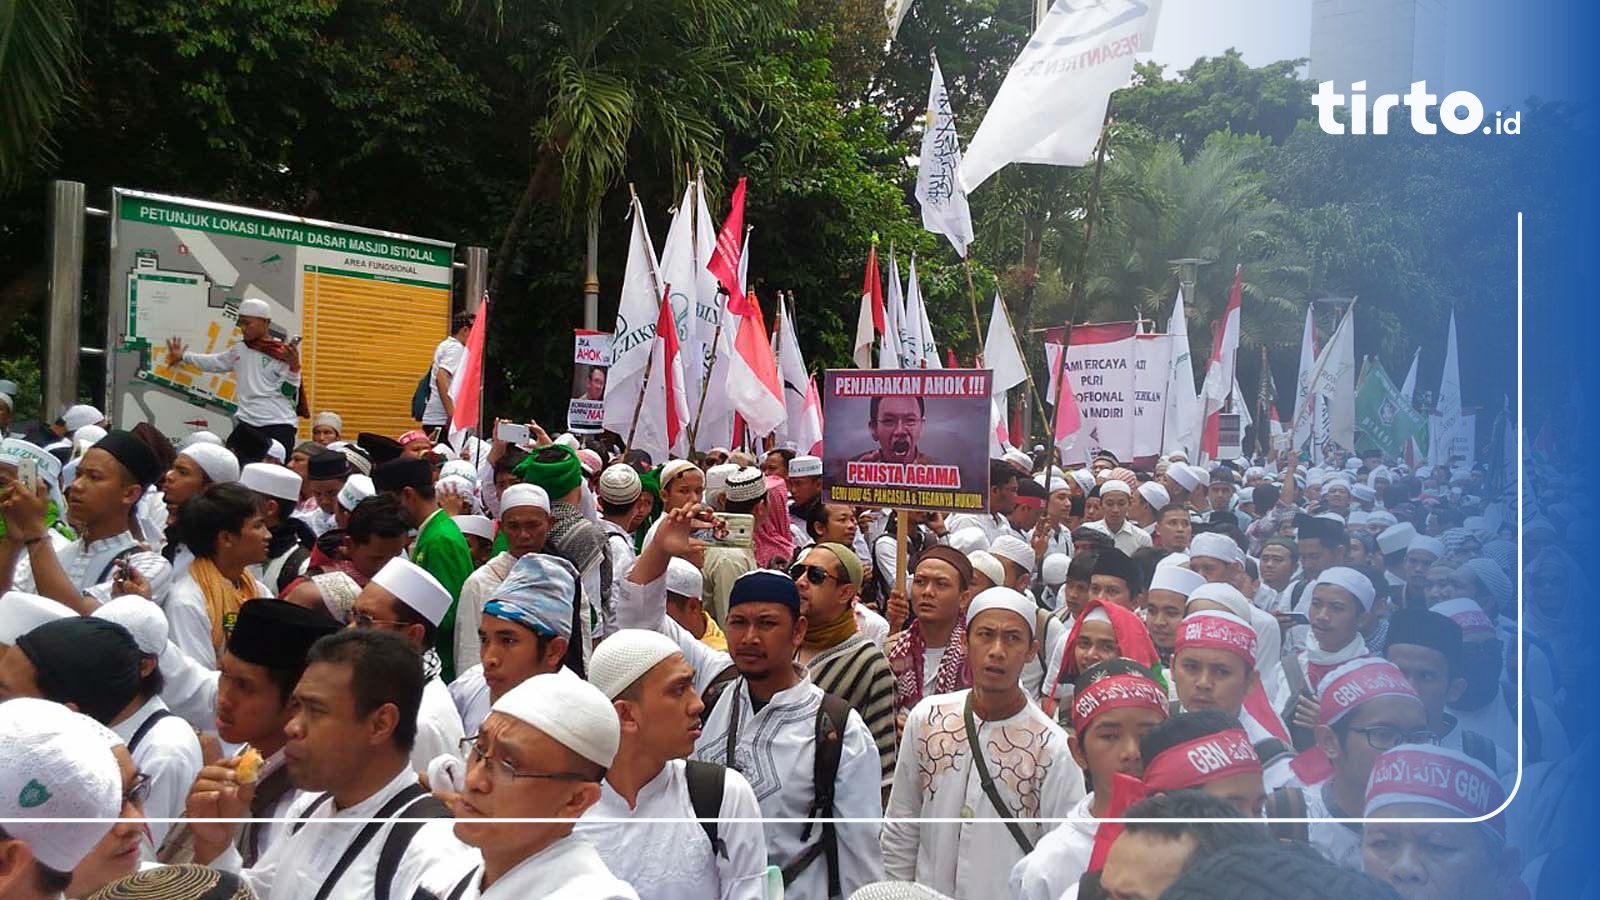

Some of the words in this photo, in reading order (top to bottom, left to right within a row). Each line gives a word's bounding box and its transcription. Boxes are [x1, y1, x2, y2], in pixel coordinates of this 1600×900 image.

[140, 206, 209, 228] PETUNJUK
[213, 217, 258, 234] LOKASI
[261, 225, 303, 242] LANTAI
[307, 232, 346, 249] DASAR
[349, 239, 388, 254] MASJID
[390, 245, 435, 262] ISTIQLAL
[344, 258, 367, 268] AREA
[368, 261, 418, 275] FUNGSIONAL
[576, 348, 602, 361] AHOK
[1063, 360, 1083, 372] AMI
[835, 376, 920, 395] PENJARAKAN
[924, 375, 965, 395] AHOK
[848, 462, 905, 484] PENISTA
[906, 464, 960, 488] AGAMA
[831, 486, 847, 501] DEMI
[874, 488, 910, 505] PANCASILA
[1184, 622, 1203, 641] GBN
[1076, 692, 1100, 718] GBN
[1333, 680, 1366, 707] GBN
[1187, 740, 1233, 774] GBN
[1454, 768, 1490, 813] GBN
